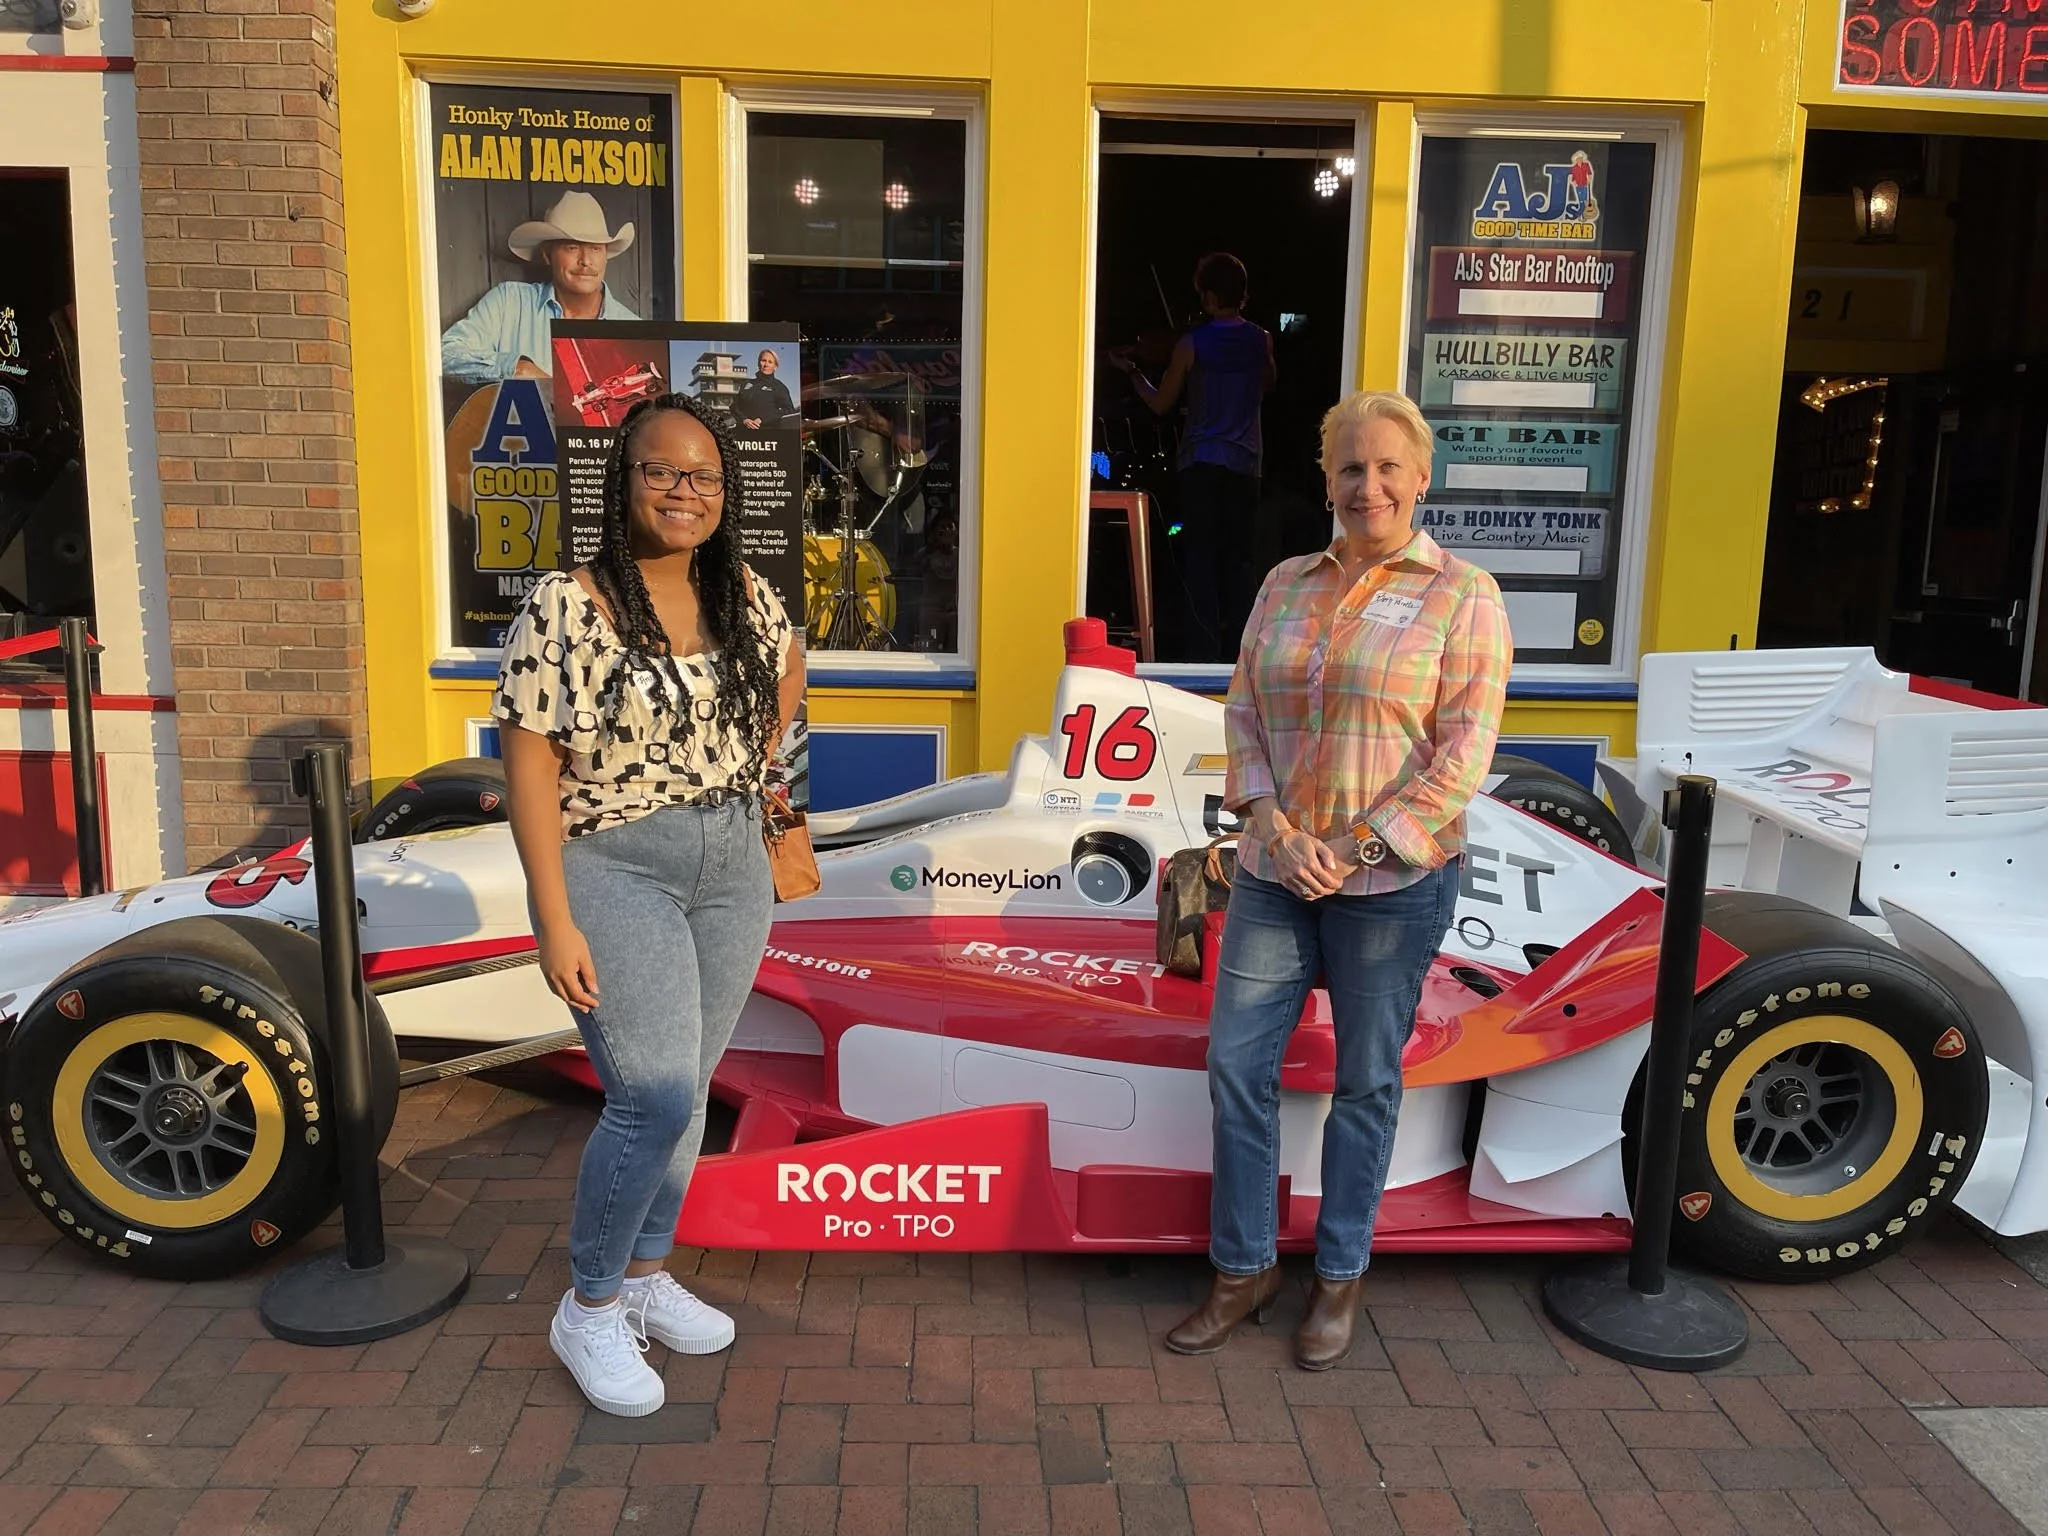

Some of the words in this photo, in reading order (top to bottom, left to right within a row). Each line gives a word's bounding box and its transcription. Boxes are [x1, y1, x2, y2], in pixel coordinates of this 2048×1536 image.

[448, 104, 514, 131] Honky
[518, 107, 568, 128] Tonk
[574, 110, 630, 131] Home
[634, 113, 656, 132] of
[440, 133, 522, 180] ALAN
[529, 137, 667, 187] JACKSON
[1475, 163, 1584, 221] AJs
[1474, 220, 1516, 237] GOOD
[1518, 221, 1560, 238] TIME
[1560, 223, 1595, 239] BAR
[1454, 252, 1484, 282] AJs
[1488, 253, 1521, 283] Star
[1524, 254, 1552, 284] Bar
[1555, 254, 1615, 290] Rooftop
[1435, 340, 1561, 368] HULLBILLY
[1568, 343, 1616, 369] BAR
[1438, 368, 1510, 380] KARAOKE
[1515, 370, 1523, 381] &
[1527, 371, 1558, 382] LIVE
[1562, 371, 1609, 383] MUSIC
[568, 438, 586, 449] NO.
[588, 439, 600, 449] 16
[1435, 426, 1493, 443] GT
[1508, 427, 1601, 445] BAR
[735, 441, 778, 452] VROLET
[1451, 444, 1494, 454] Watch
[1498, 446, 1529, 456] your
[1531, 446, 1583, 455] favorite
[569, 457, 595, 465] Paretta
[1468, 454, 1526, 464] sporting
[1529, 455, 1565, 463] event
[569, 467, 602, 475] executive
[773, 470, 787, 478] 500
[474, 466, 558, 497] GOOD
[570, 487, 583, 495] the
[744, 509, 771, 517] Penske.
[763, 500, 786, 509] engine
[1421, 509, 1456, 527] AJs
[1463, 510, 1537, 528] HONKY
[1542, 512, 1602, 529] TONK
[573, 536, 588, 545] girls
[762, 538, 788, 546] Created
[764, 529, 784, 538] young
[1431, 528, 1463, 542] Live
[1471, 528, 1536, 547] Country
[1542, 530, 1591, 546] Music
[573, 545, 582, 554] by
[583, 545, 599, 553] Beth
[775, 547, 785, 555] for
[497, 576, 541, 597] NAS
[1061, 704, 1157, 782] 16
[1060, 796, 1078, 804] NTT
[921, 866, 1062, 894] MoneyLion
[765, 945, 872, 980] irestone
[961, 941, 1168, 978] ROCKET
[993, 963, 1040, 976] Pro
[1063, 970, 1122, 985] TPO
[199, 984, 322, 1147] Firestone
[8, 1101, 132, 1259] Firestone
[777, 1163, 1002, 1204] ROCKET
[1778, 1134, 1967, 1265] Firestone
[824, 1215, 872, 1238] Pro
[892, 1215, 955, 1238] TPO
